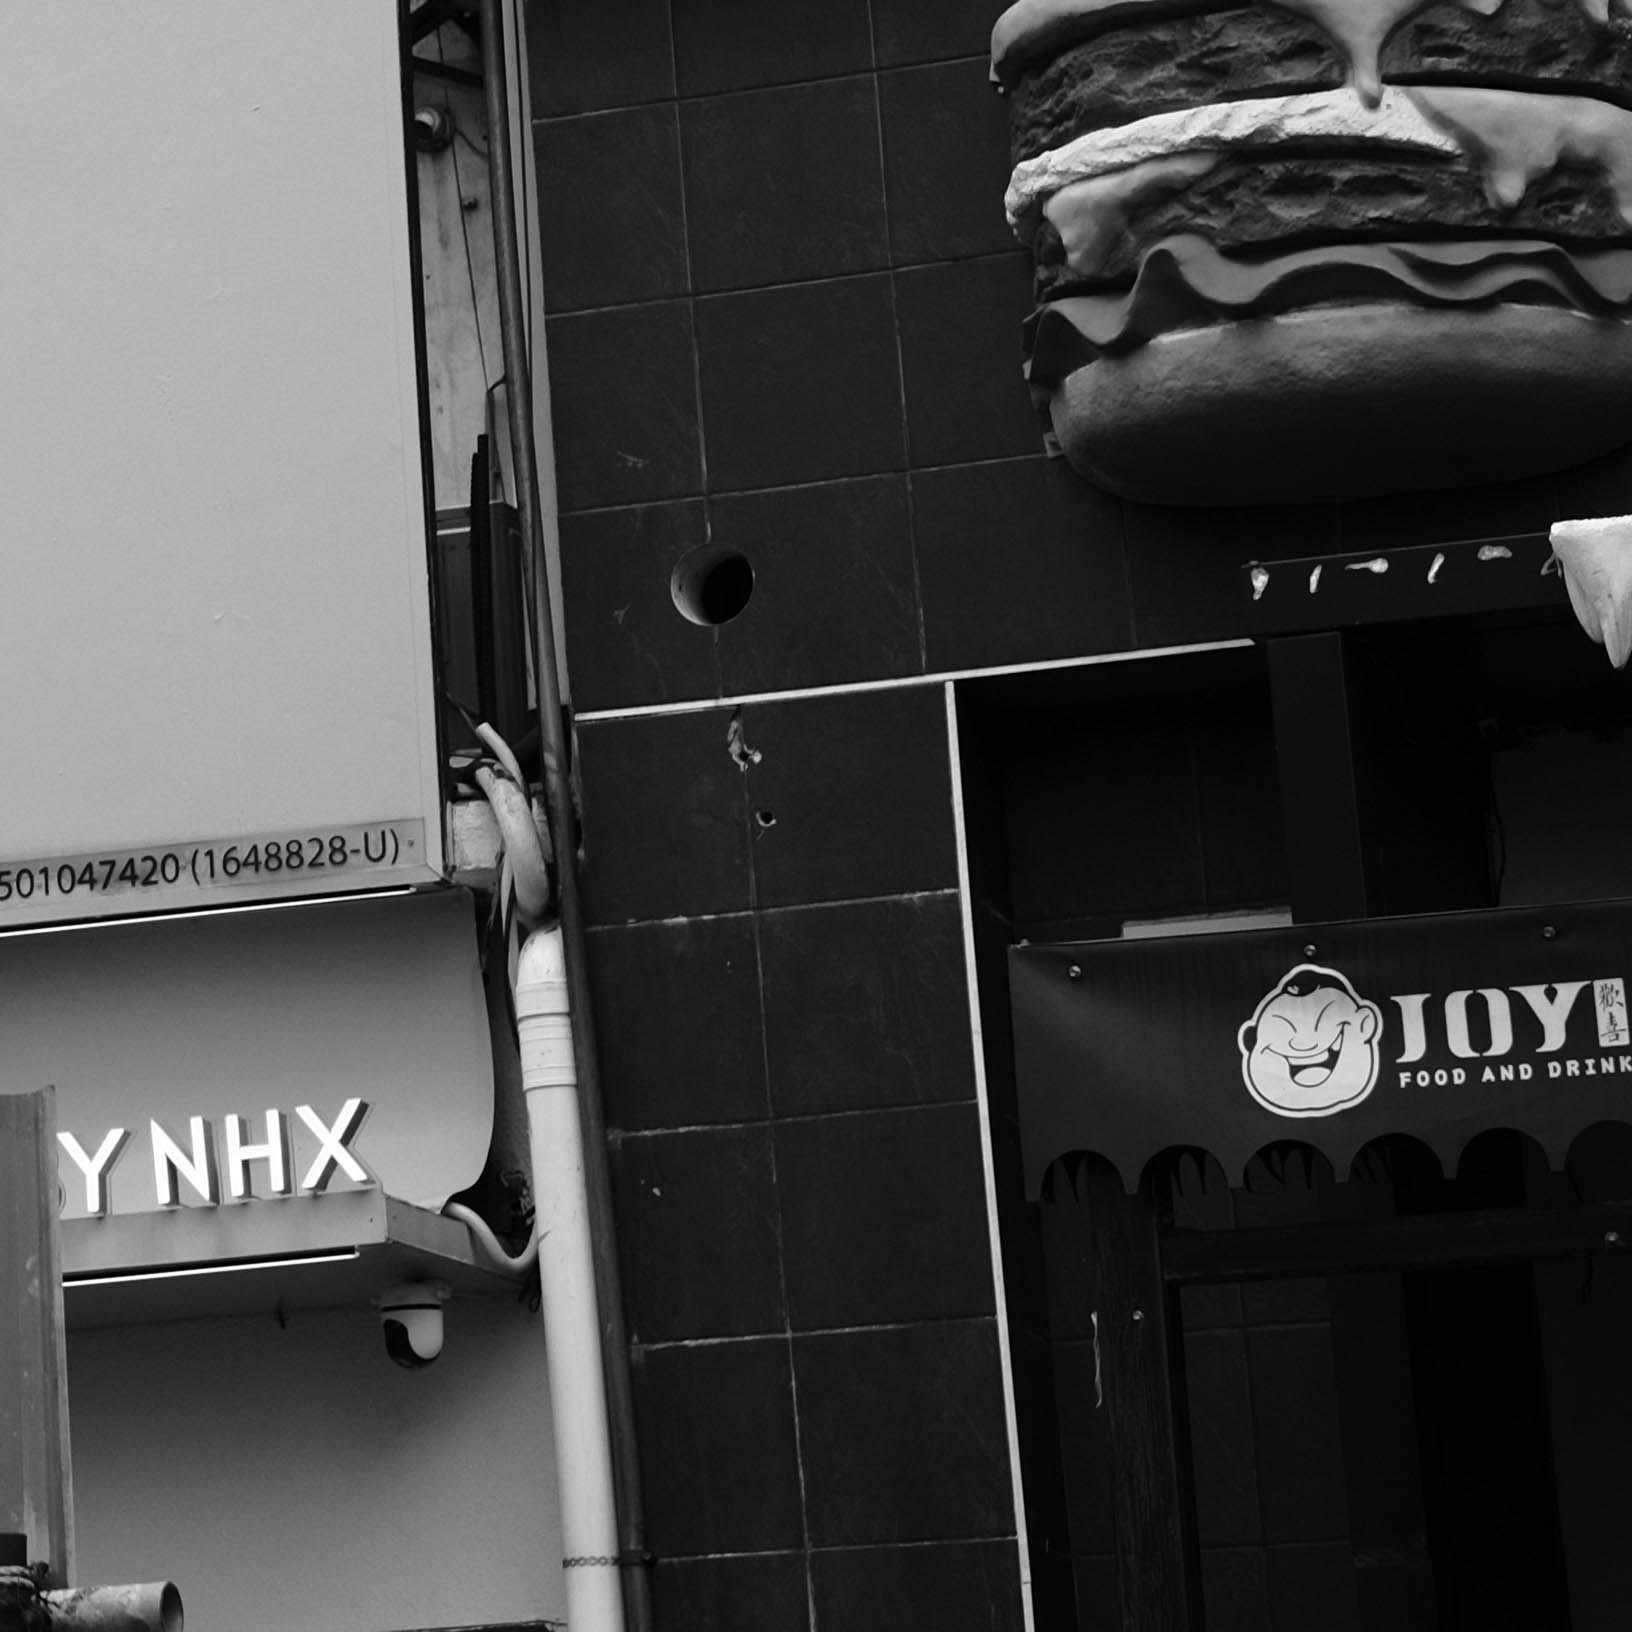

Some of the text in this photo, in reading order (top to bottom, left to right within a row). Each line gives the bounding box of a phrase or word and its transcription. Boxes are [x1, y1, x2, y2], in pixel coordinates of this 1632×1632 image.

[191, 828, 399, 886] (1648828-U)
[1389, 980, 1592, 1064] JOY
[1397, 1055, 1632, 1089] FOOD AND DRINK
[56, 1127, 129, 1214] Y
